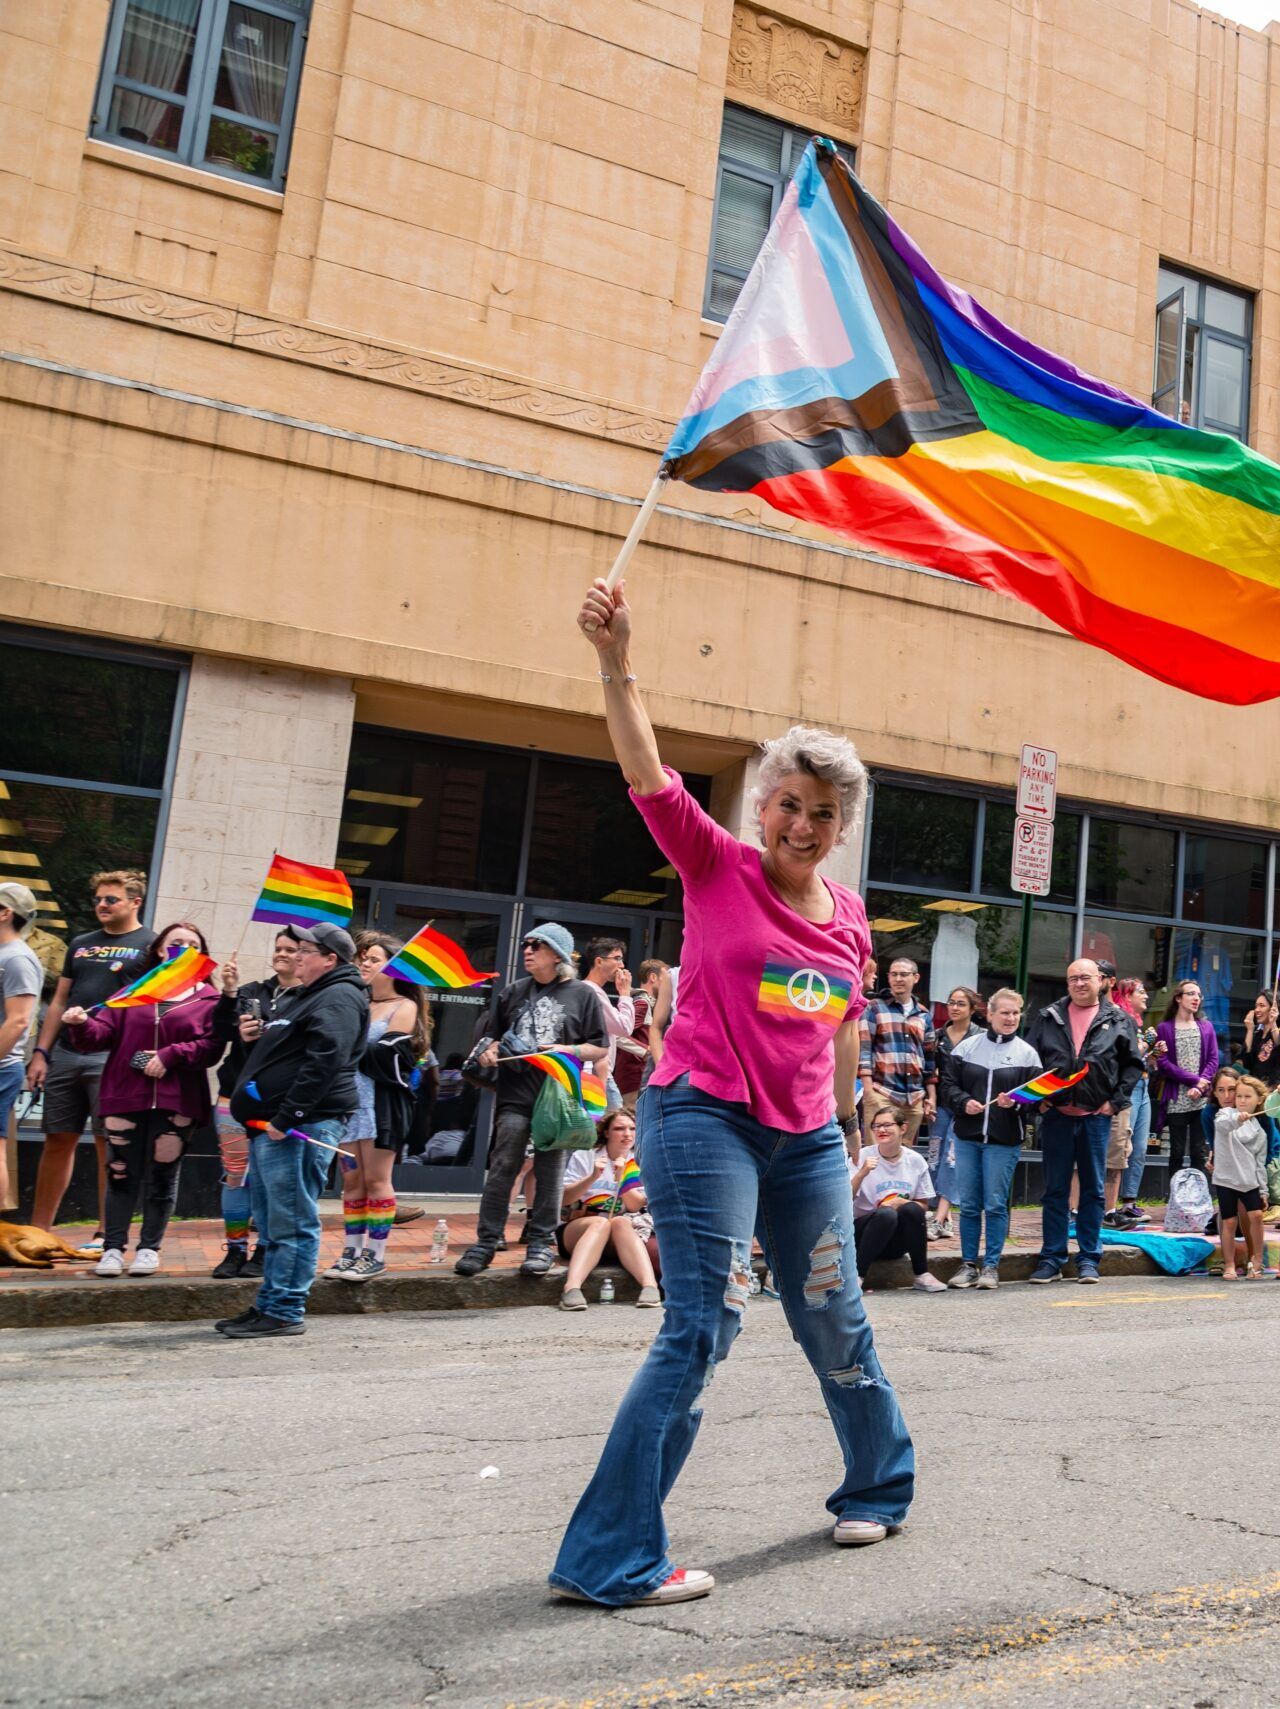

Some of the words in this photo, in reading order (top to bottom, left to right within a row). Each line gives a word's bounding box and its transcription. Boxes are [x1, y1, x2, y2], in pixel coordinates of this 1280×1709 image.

[1032, 752, 1047, 767] NO
[1022, 765, 1055, 785] PARKING
[1029, 783, 1045, 794] ANY
[1028, 793, 1045, 805] TIME
[440, 994, 486, 1005] ENTRANCE
